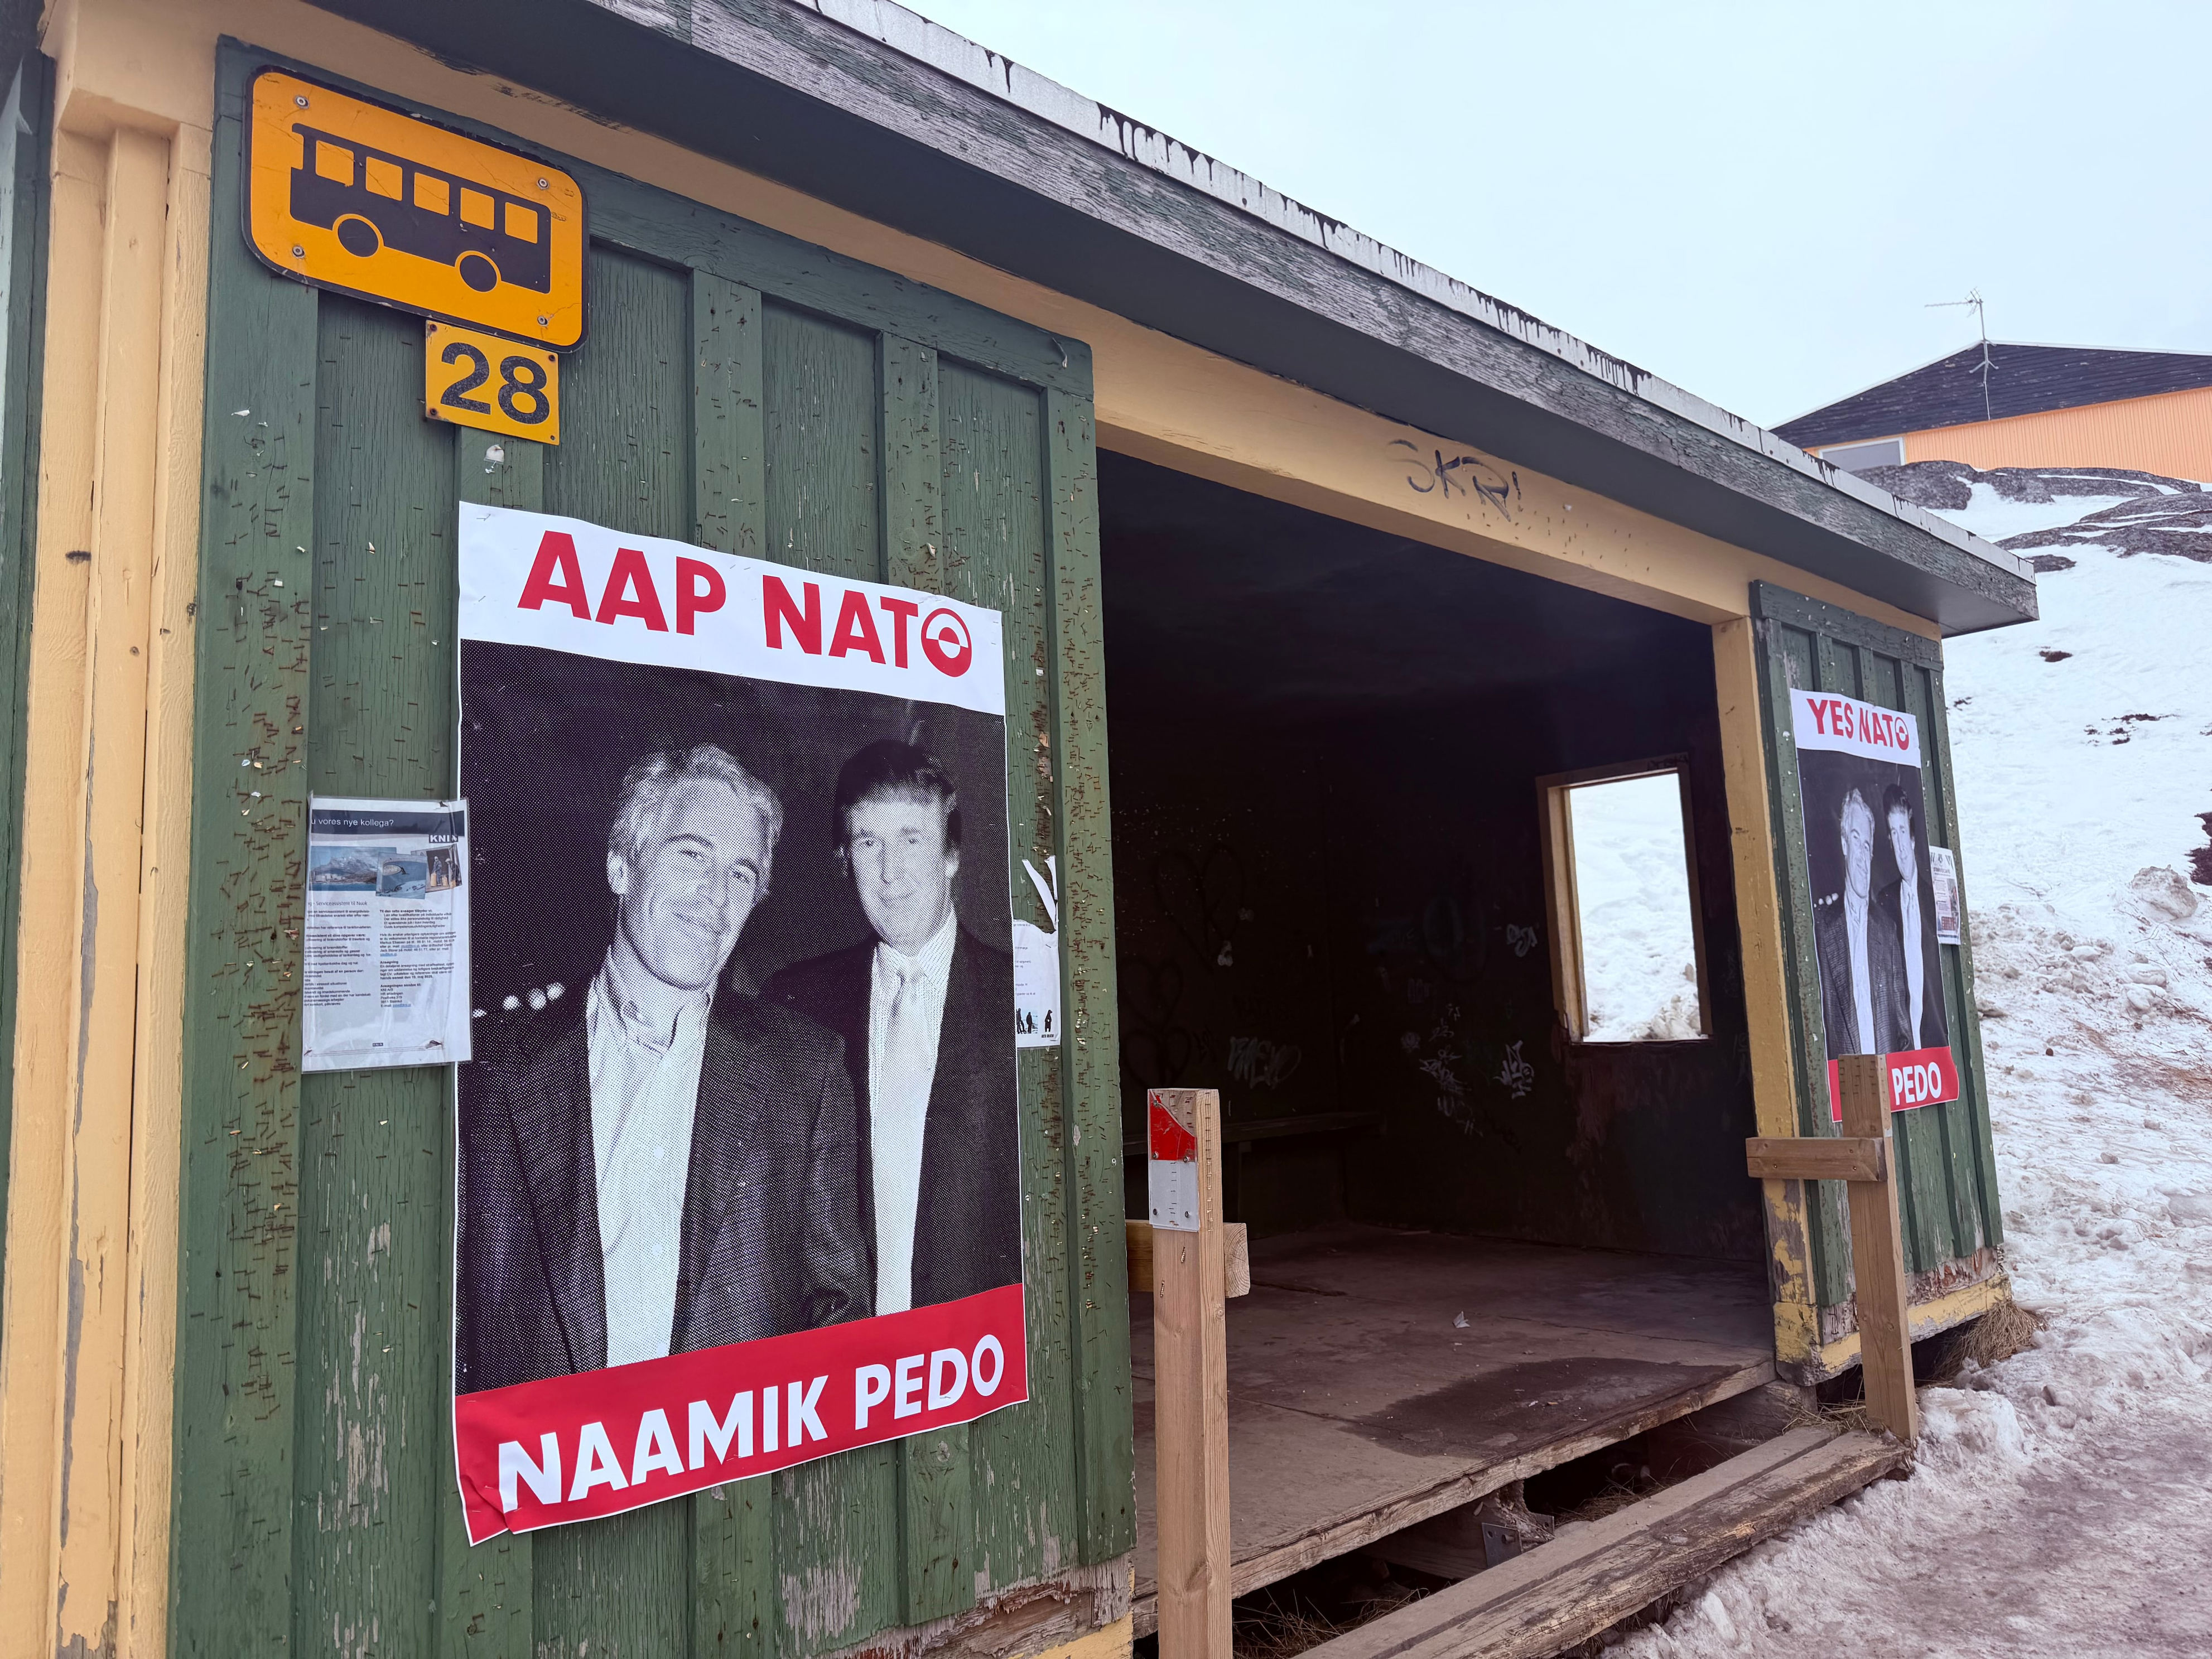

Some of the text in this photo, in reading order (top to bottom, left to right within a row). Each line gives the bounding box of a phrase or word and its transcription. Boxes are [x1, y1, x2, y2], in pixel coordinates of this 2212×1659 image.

[440, 342, 550, 425] 28
[518, 531, 972, 678] AAP NATO
[1806, 698, 1910, 751] YES NATO
[344, 819, 358, 828] nye
[360, 819, 394, 828] kollega?
[1891, 1062, 1943, 1106] PEDO
[498, 1334, 1005, 1514] NAAMIK PEDO
